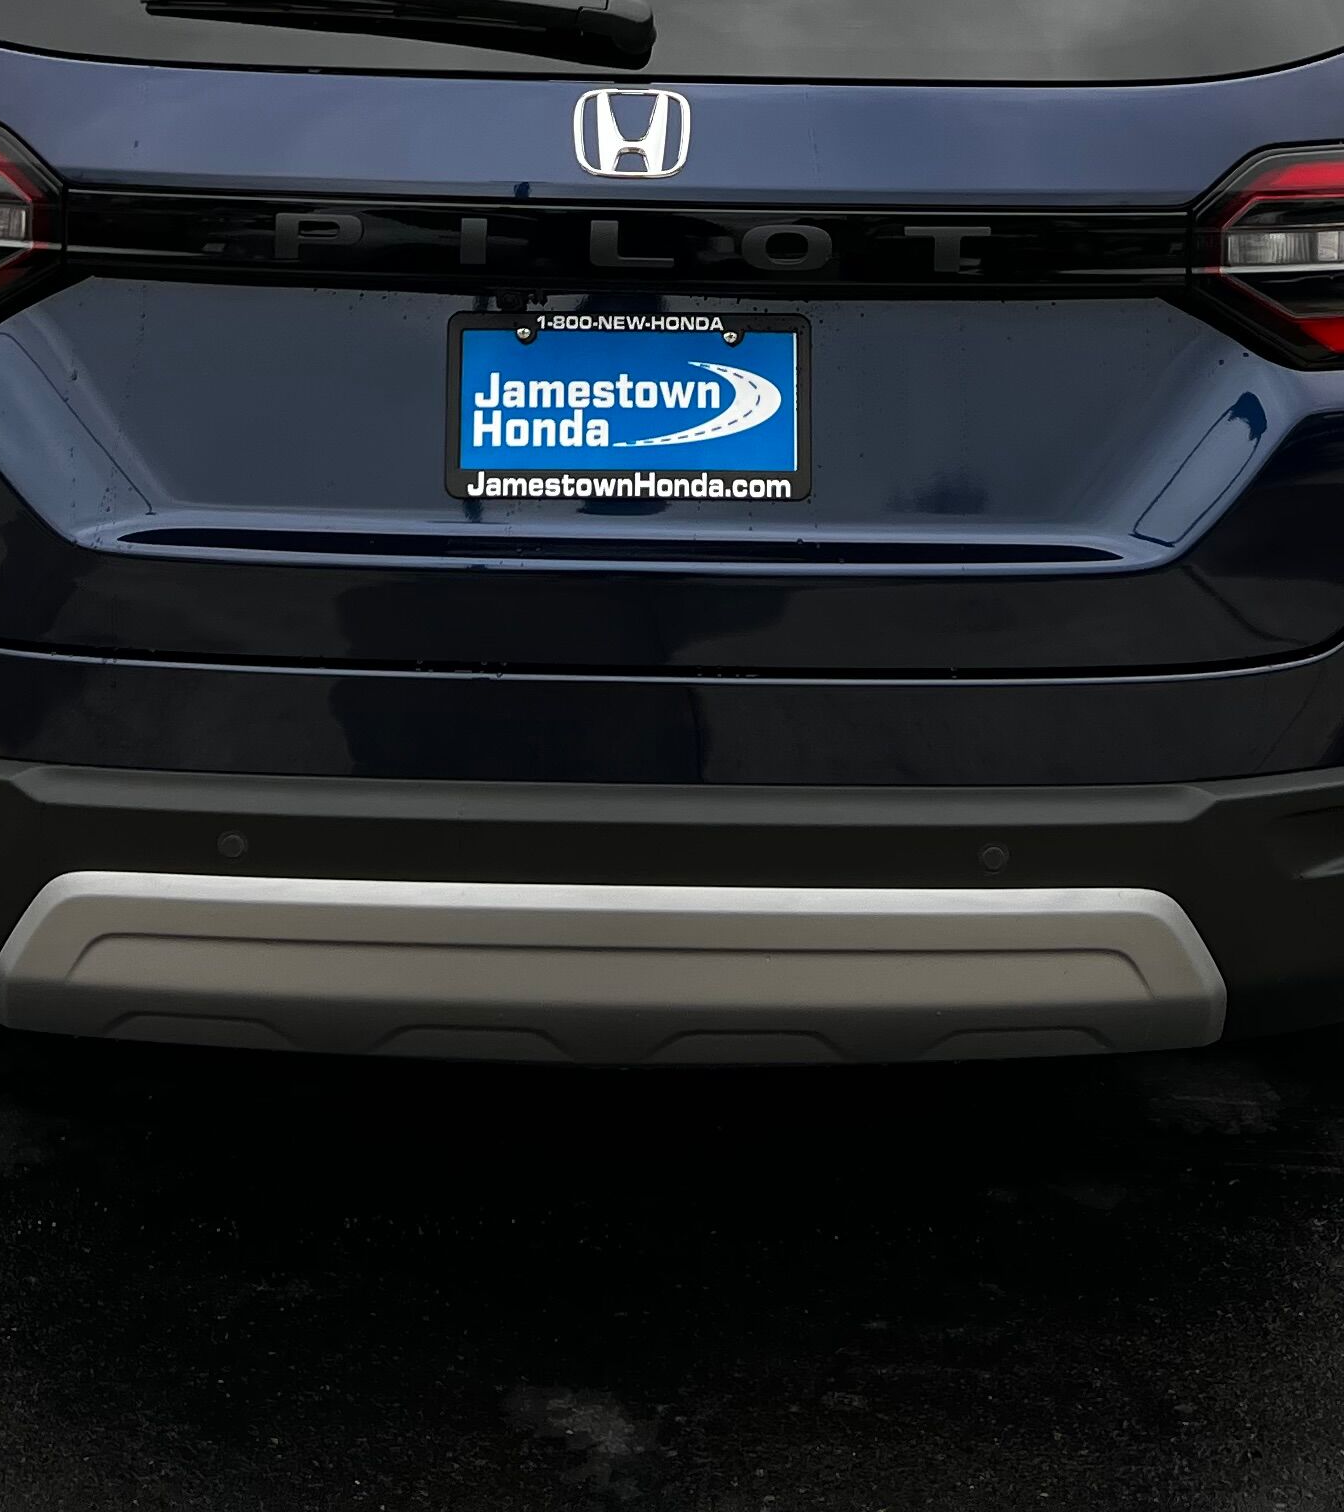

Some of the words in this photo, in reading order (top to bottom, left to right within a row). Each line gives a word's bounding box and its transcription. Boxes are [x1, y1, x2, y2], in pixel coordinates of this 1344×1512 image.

[272, 210, 993, 276] PILOT
[536, 315, 725, 332] 1-800-NEW-HONDA
[474, 372, 722, 409] Jamestown
[472, 408, 610, 448] Honda
[467, 470, 792, 499] JamestownHonda.com
